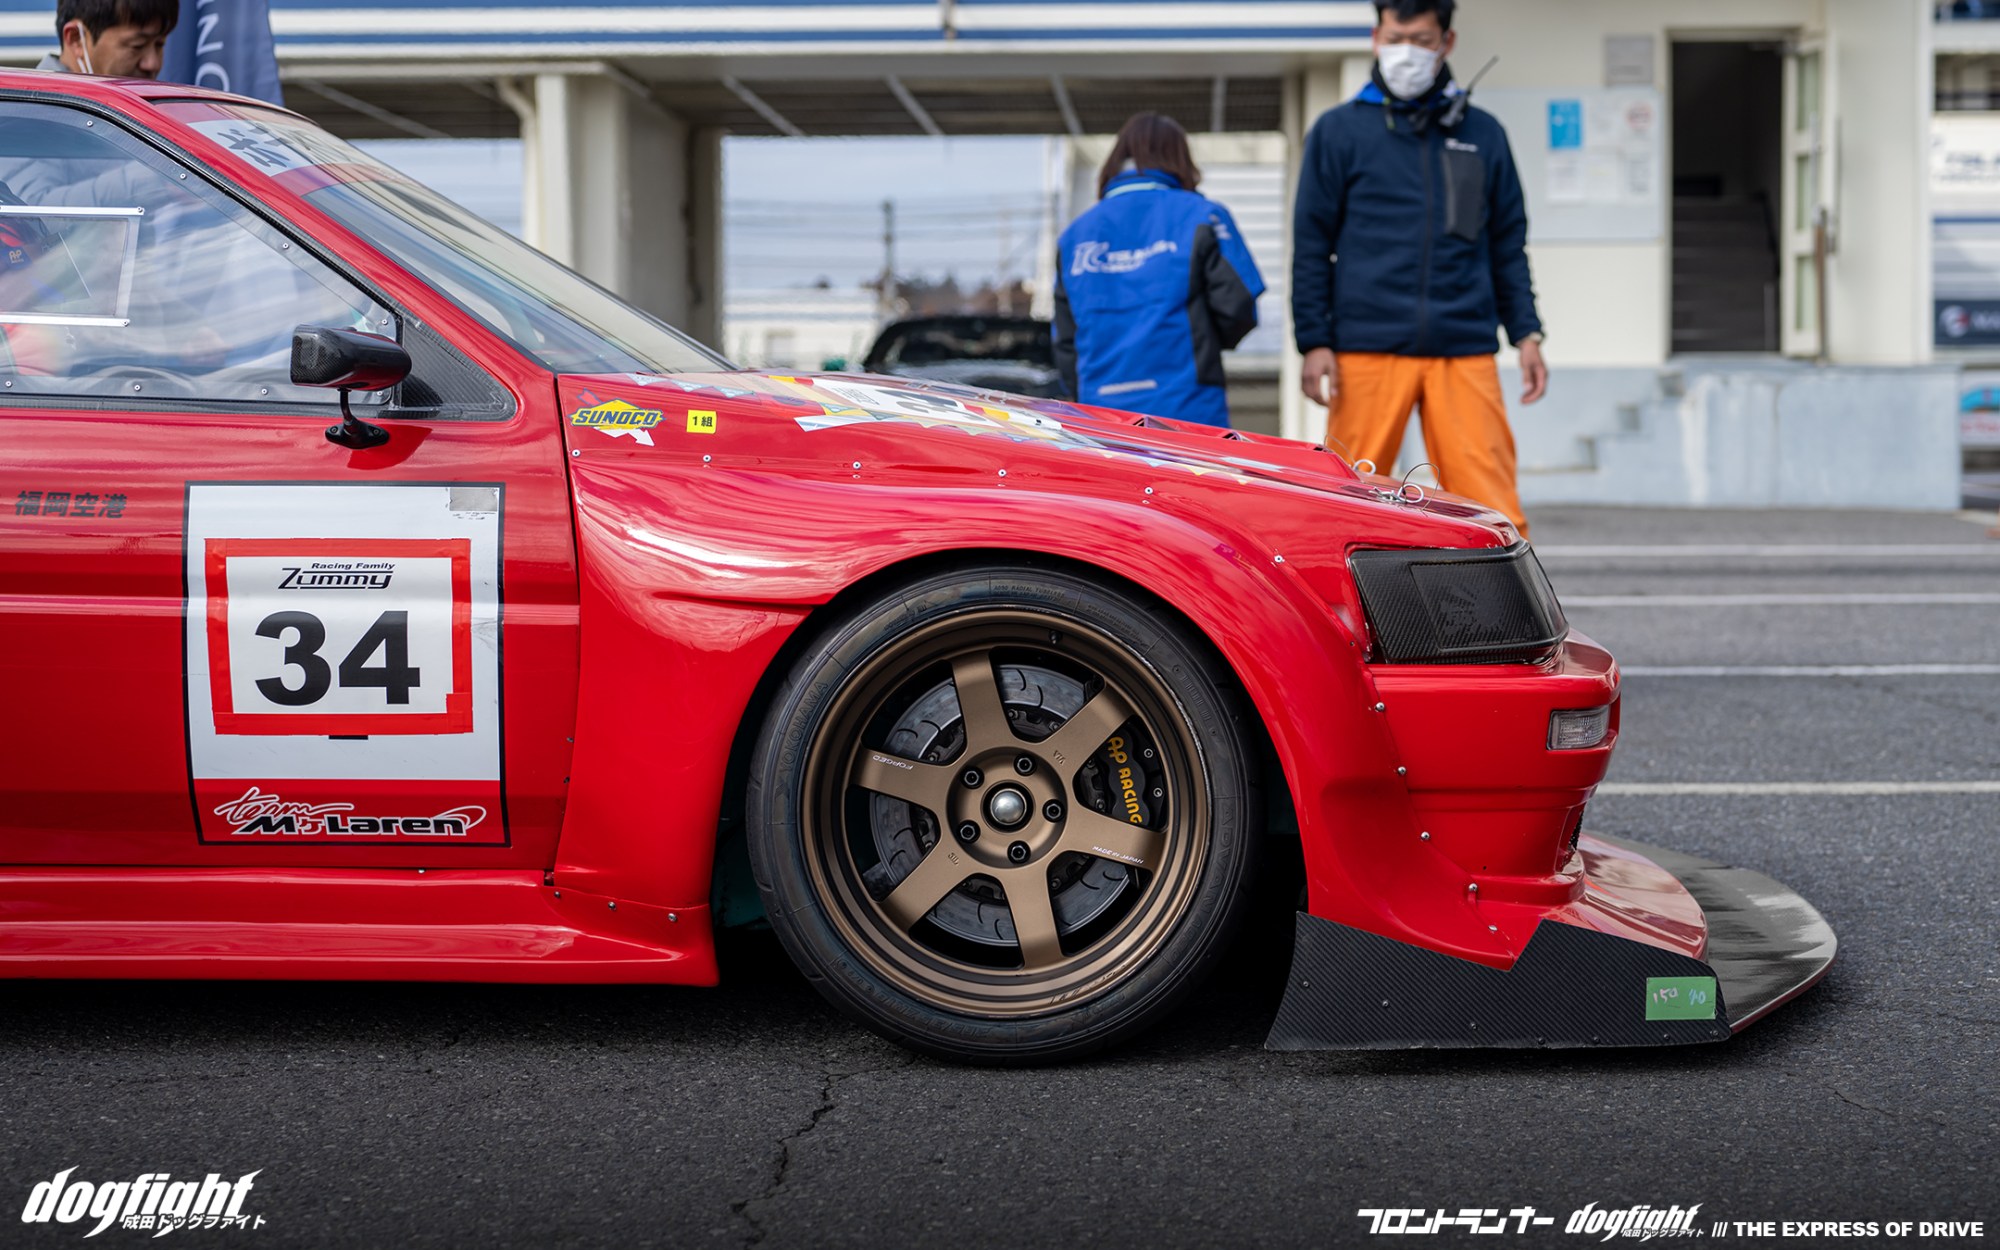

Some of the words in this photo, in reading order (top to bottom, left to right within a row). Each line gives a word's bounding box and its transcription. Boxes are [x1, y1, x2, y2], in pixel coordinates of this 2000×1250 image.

[575, 409, 659, 426] SUNOCO
[692, 415, 713, 428] 1組
[15, 490, 127, 519] 福岡空港
[311, 562, 352, 570] Racing
[355, 562, 395, 570] Family
[278, 567, 394, 590] Zummy
[254, 609, 421, 707] 34
[780, 680, 829, 773] YOKOHAMA
[872, 754, 914, 771] FORGED
[1106, 736, 1128, 765] AP
[1118, 767, 1143, 824] RACING
[214, 786, 355, 825] team
[1092, 845, 1113, 856] MADE
[1119, 853, 1145, 865] JAPAN
